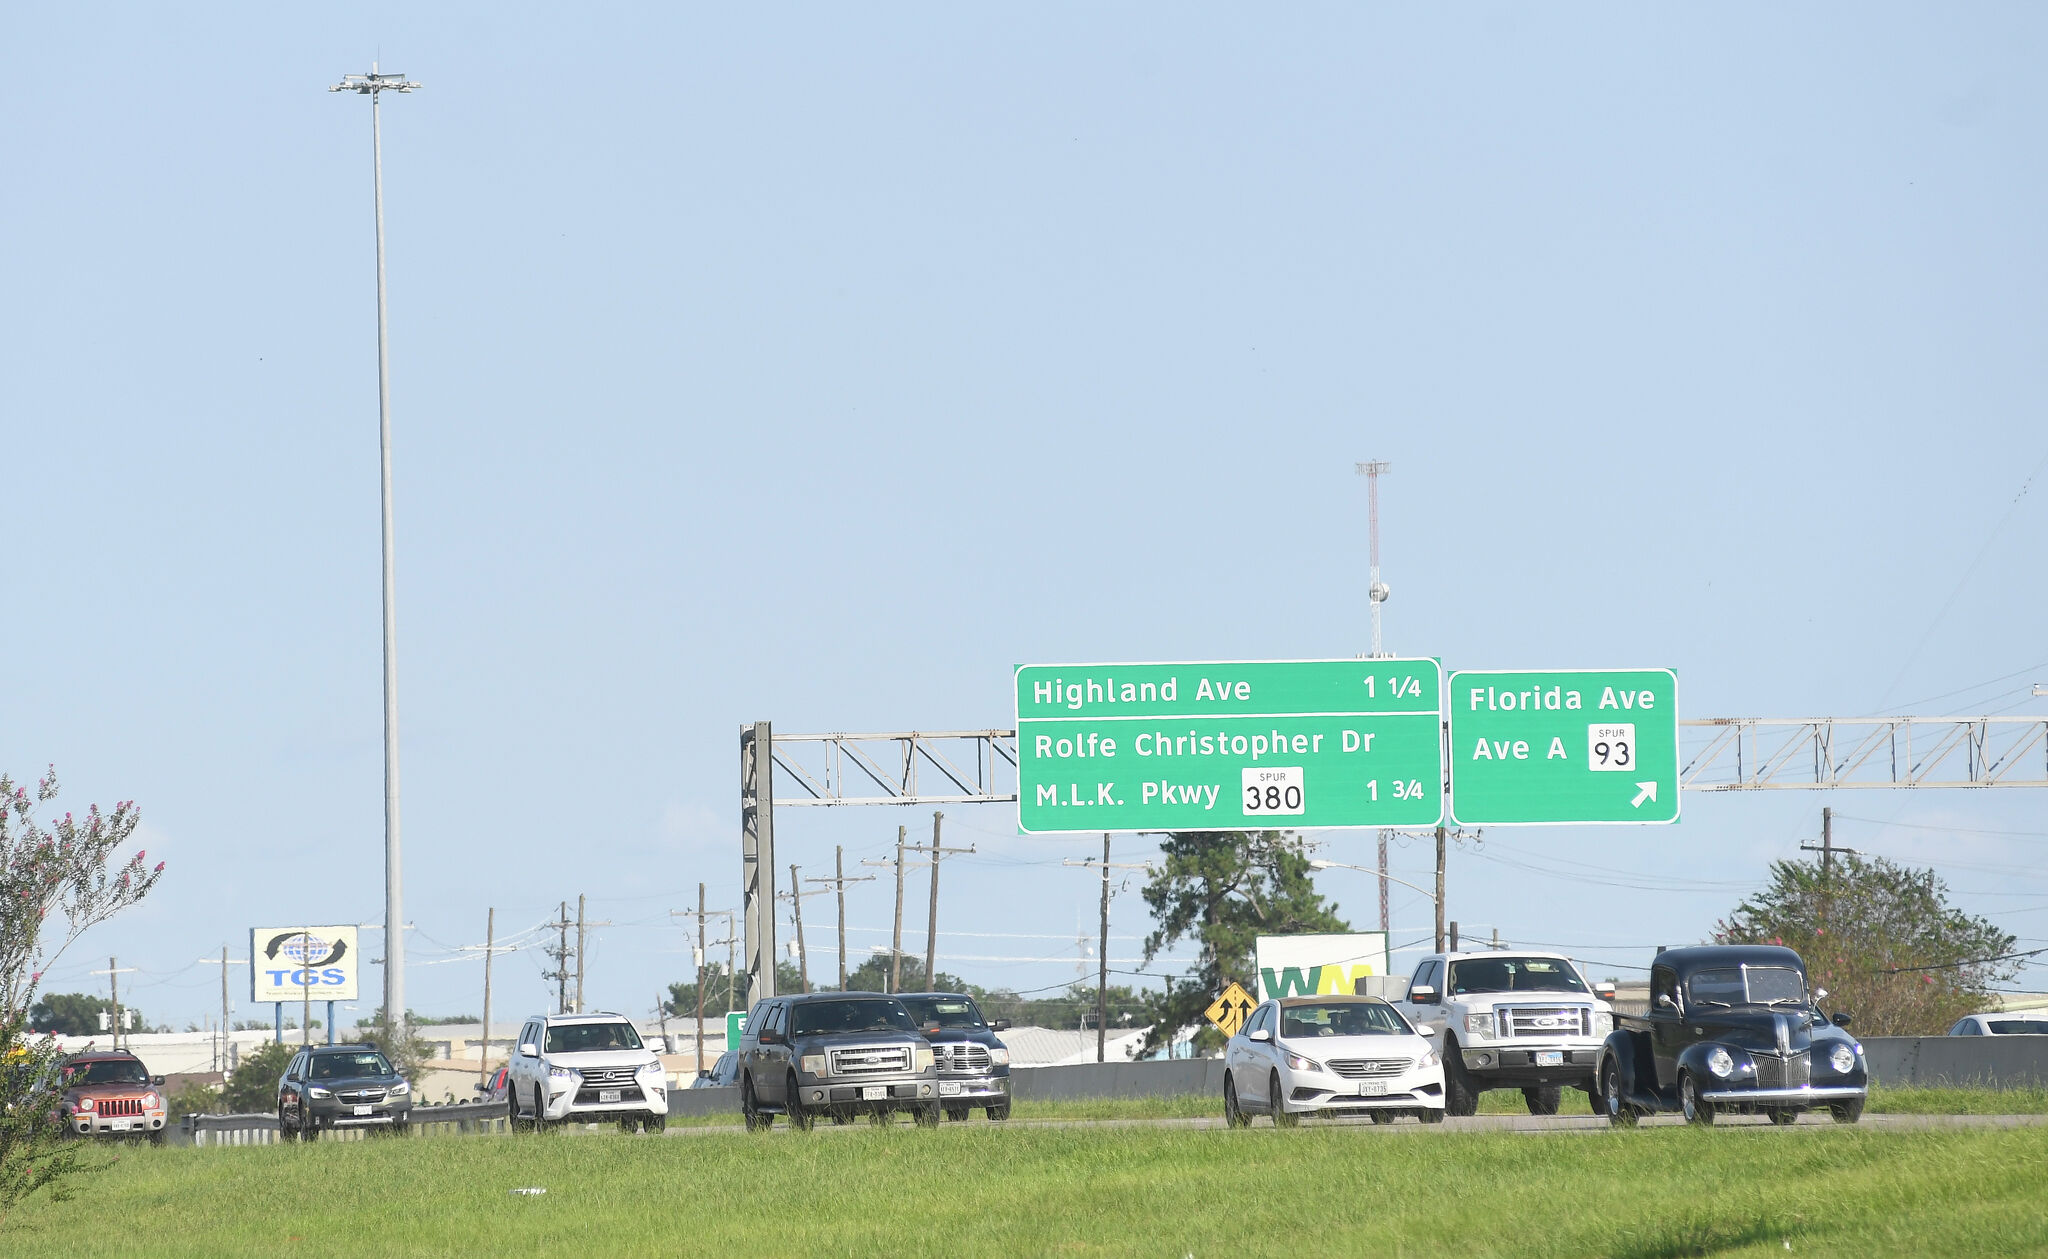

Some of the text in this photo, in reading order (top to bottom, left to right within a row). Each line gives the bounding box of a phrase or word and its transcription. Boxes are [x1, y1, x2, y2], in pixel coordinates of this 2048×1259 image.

[1033, 677, 1251, 710] Highland Ave
[1363, 676, 1375, 698] 1
[1470, 685, 1655, 711] Florida Ave
[1035, 730, 1375, 759] Rolfe Christopher Dr
[1599, 729, 1624, 738] SPUR
[1473, 737, 1567, 760] Ave A
[1595, 742, 1630, 765] 93
[1259, 772, 1286, 782] SPUR
[1036, 780, 1220, 810] M.L.K. Pkwy
[1246, 785, 1301, 810] 380
[1366, 780, 1378, 801] 1
[266, 968, 345, 986] TGS
[1260, 964, 1373, 999] WM
